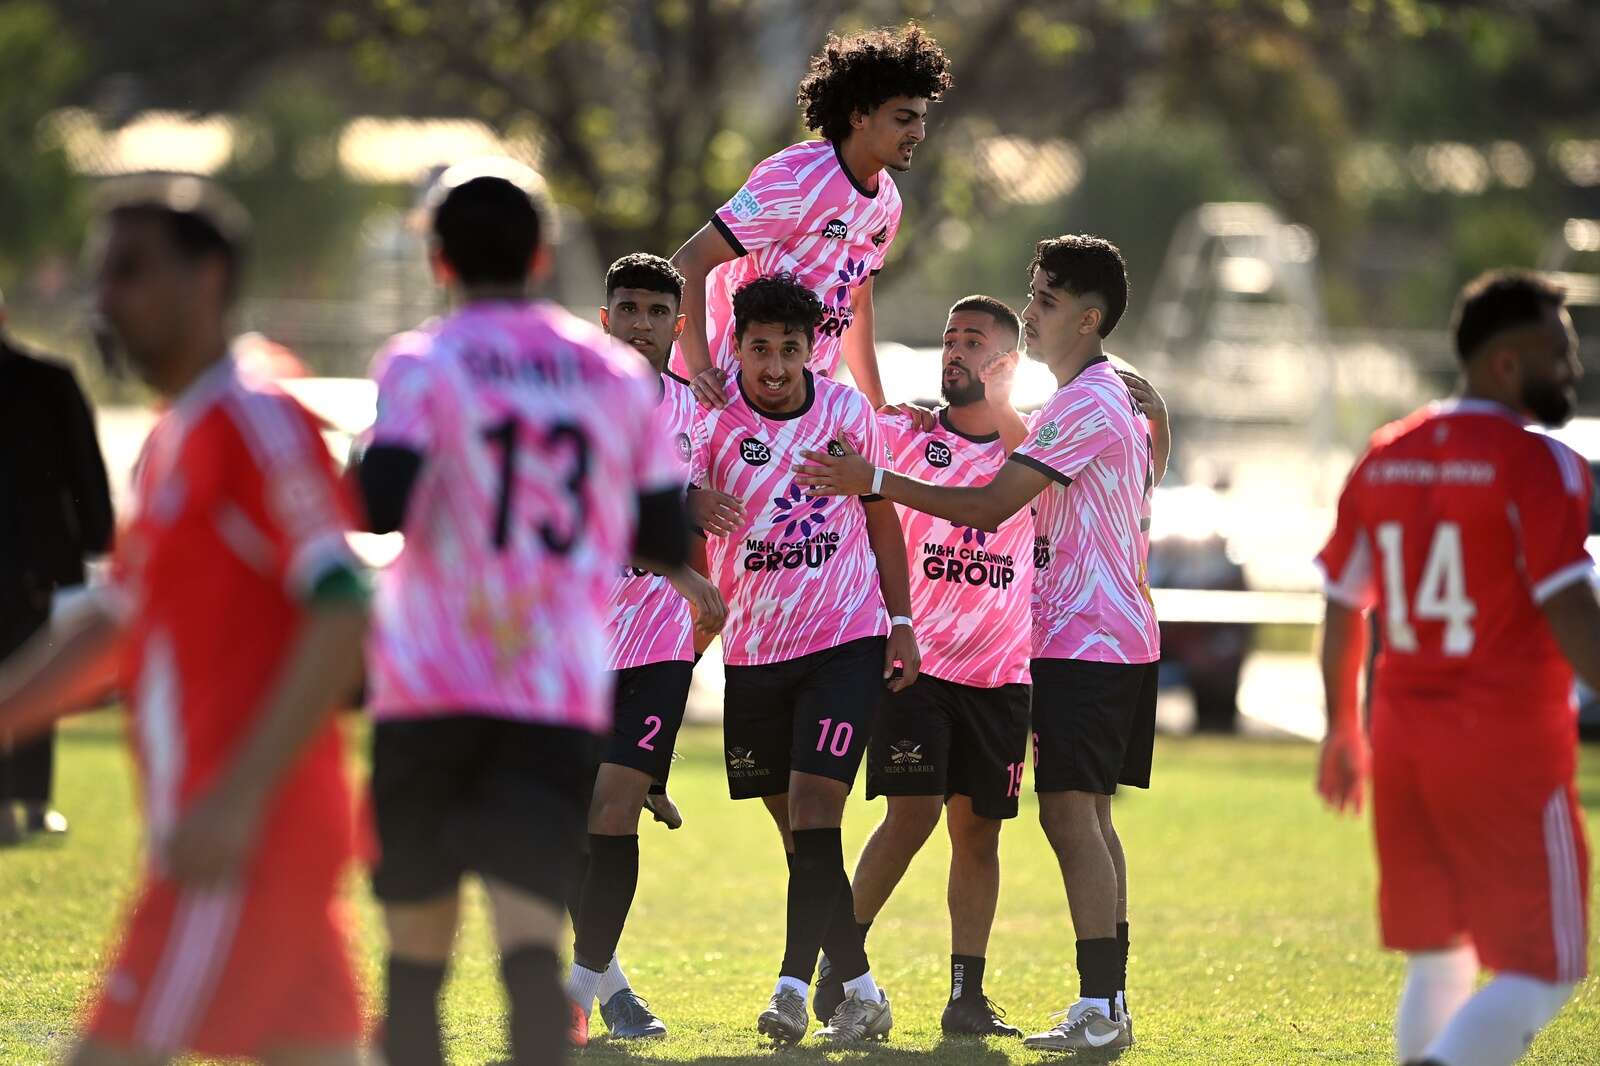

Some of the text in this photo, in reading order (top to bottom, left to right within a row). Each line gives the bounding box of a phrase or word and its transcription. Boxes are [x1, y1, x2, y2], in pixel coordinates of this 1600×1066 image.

[828, 224, 847, 235] NEO
[743, 441, 767, 452] NEO
[743, 451, 769, 461] CLO
[928, 452, 949, 465] CLO
[929, 443, 950, 458] NEO
[482, 416, 590, 555] 13
[744, 544, 838, 572] GROUP
[746, 539, 775, 553] M&H
[924, 543, 955, 558] M&H
[959, 548, 1014, 567] CLEANING
[923, 556, 1015, 590] GROUP
[1378, 521, 1477, 657] 14
[637, 715, 662, 751] 2
[816, 717, 854, 757] 10
